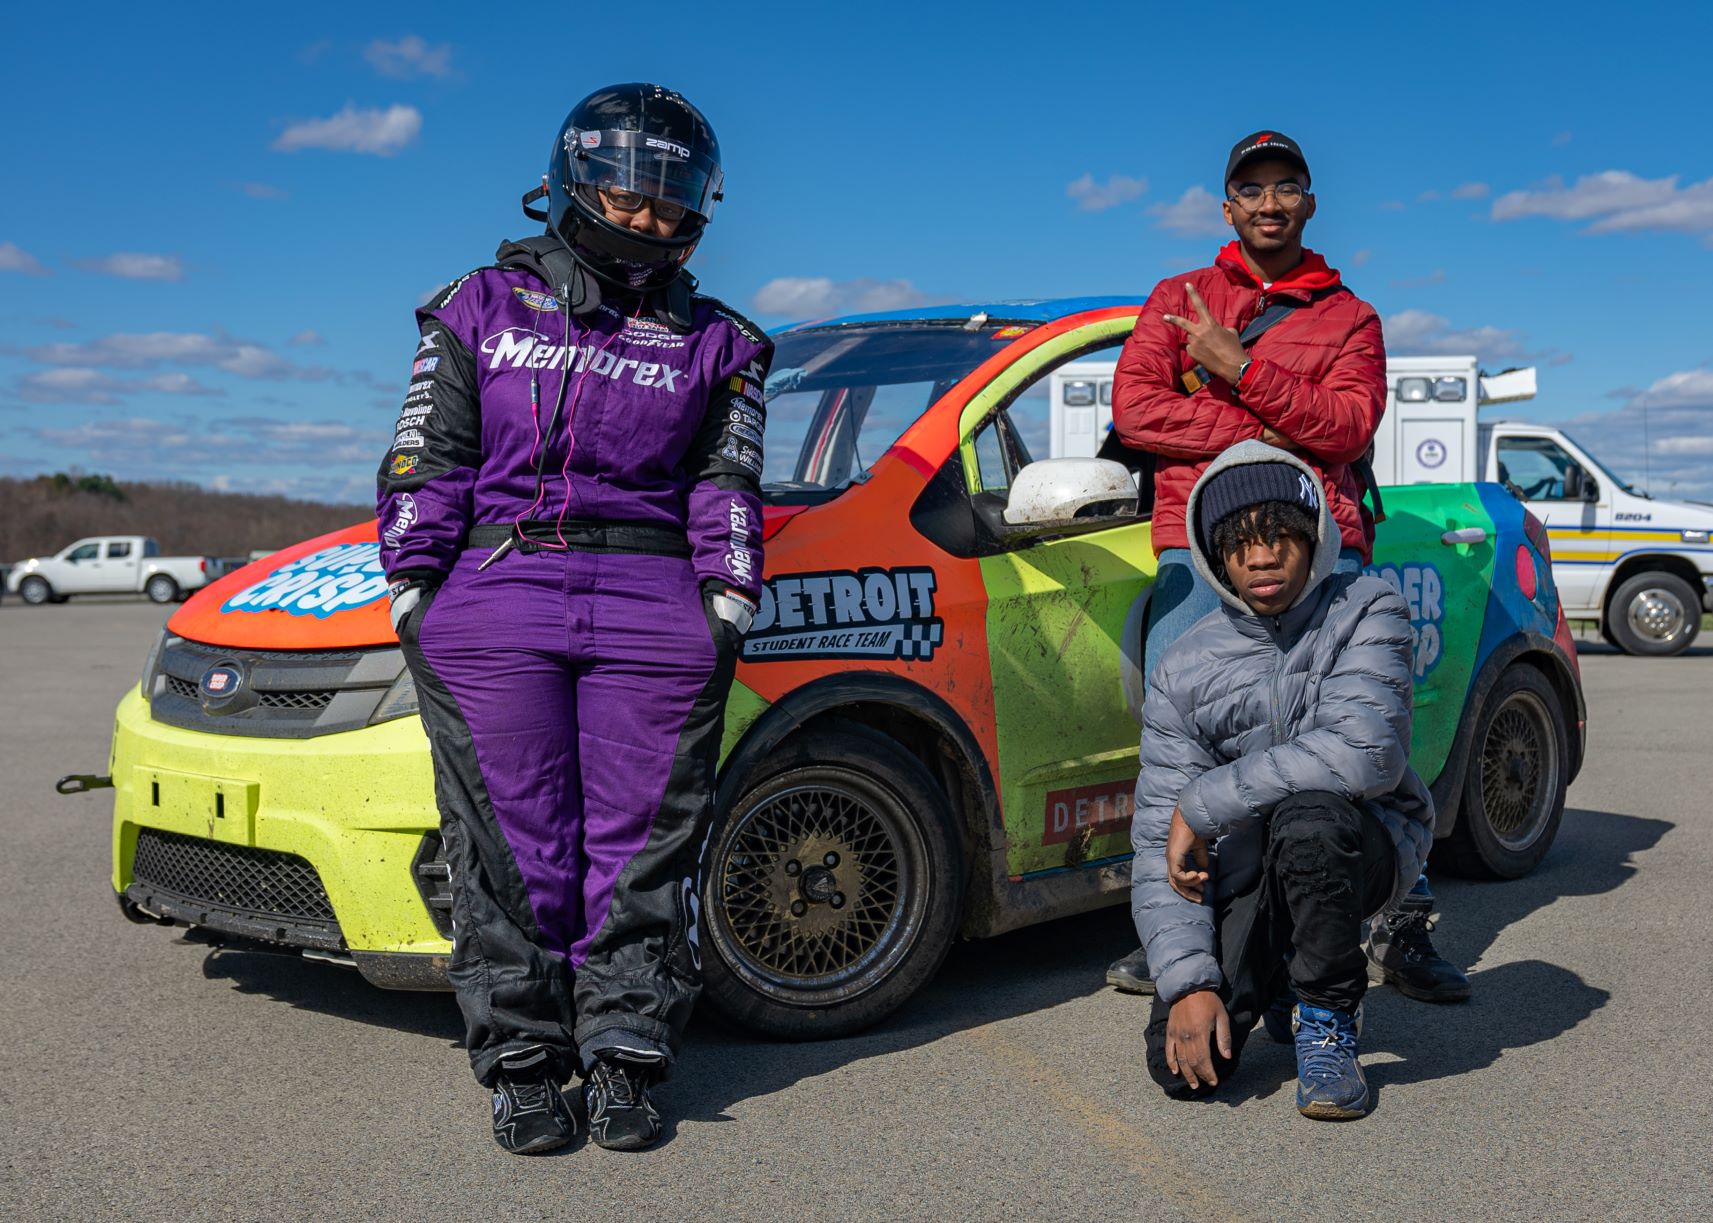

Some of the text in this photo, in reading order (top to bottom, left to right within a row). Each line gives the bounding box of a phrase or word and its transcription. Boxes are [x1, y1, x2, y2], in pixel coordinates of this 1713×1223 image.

[645, 137, 691, 159] zamp
[228, 570, 390, 613] CRISP
[750, 572, 936, 632] DETROIT
[752, 630, 892, 653] STUDENT RACE TEAM
